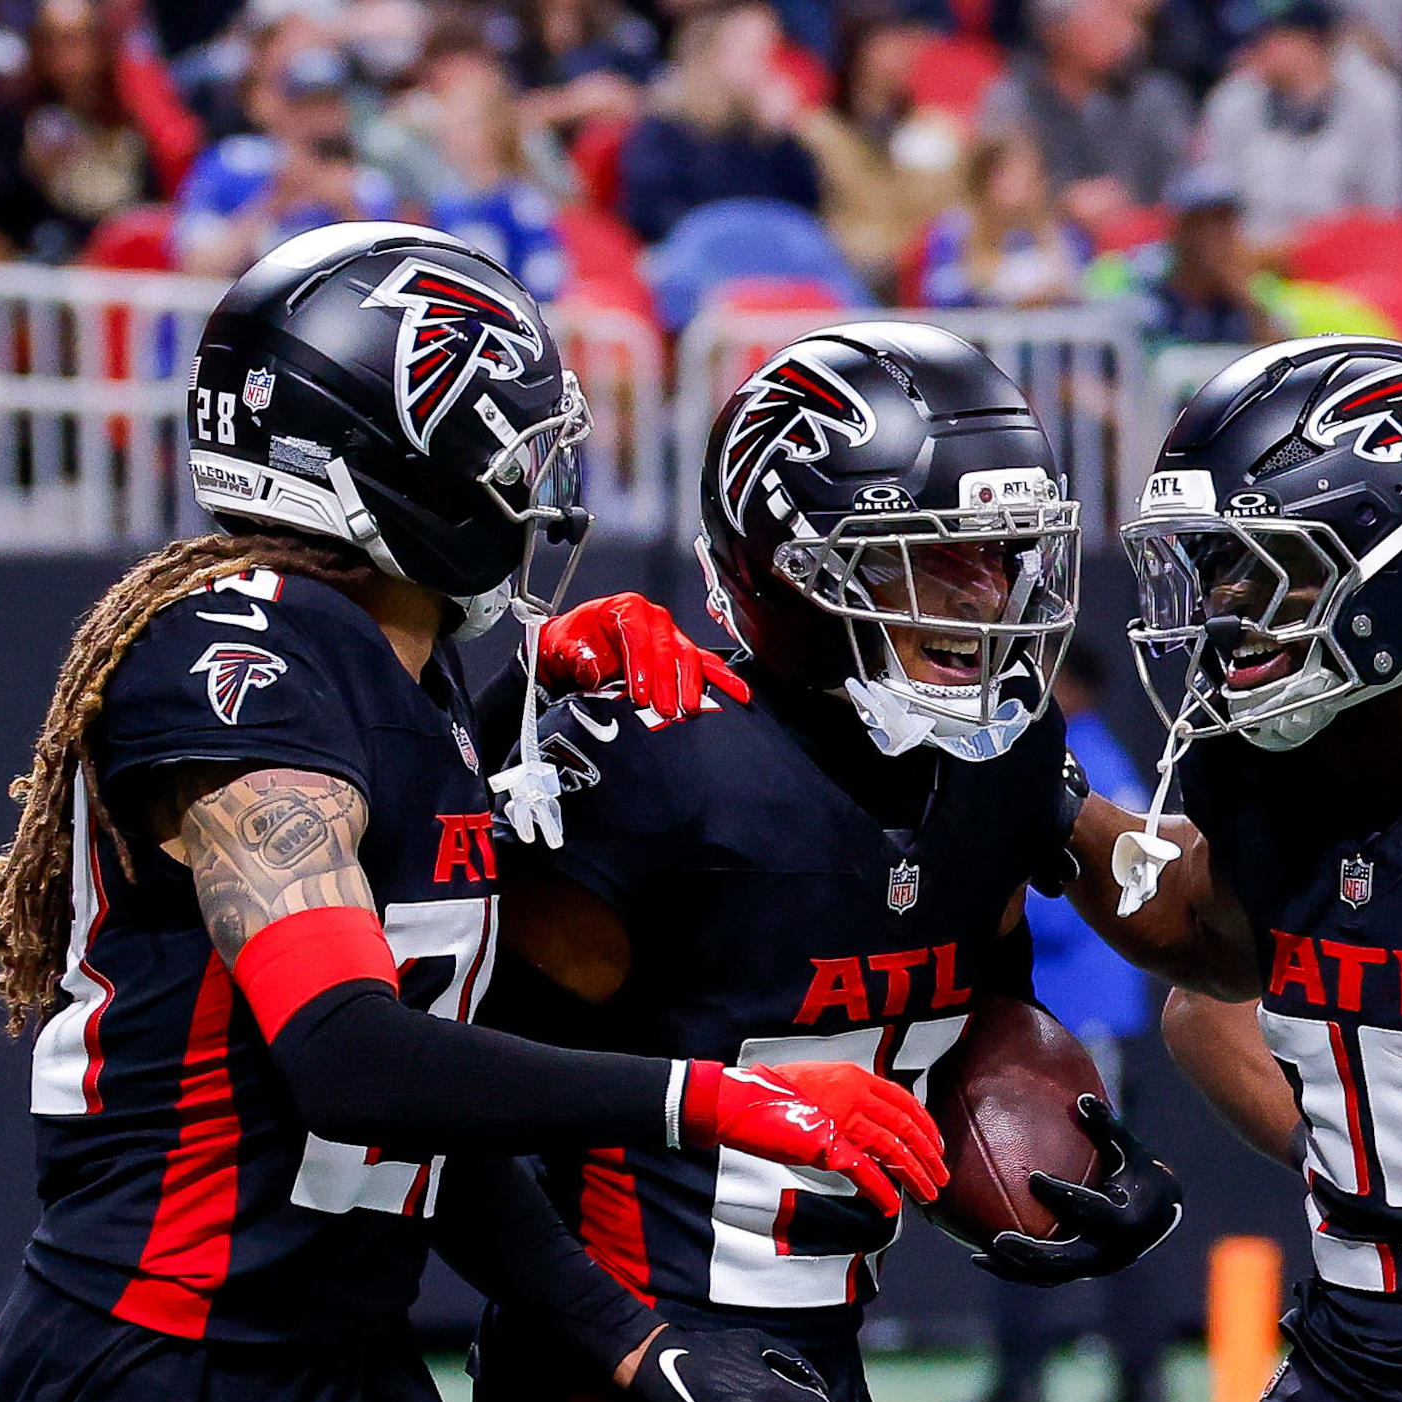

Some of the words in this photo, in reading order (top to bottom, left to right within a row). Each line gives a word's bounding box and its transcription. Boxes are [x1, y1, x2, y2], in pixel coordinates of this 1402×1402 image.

[246, 385, 267, 405] NFL
[197, 387, 237, 446] 28
[1004, 481, 1031, 495] ATL
[1150, 477, 1183, 495] ATL
[854, 501, 911, 511] OAKLEY
[1223, 506, 1278, 518] OAKLEY
[893, 885, 915, 905] NFL
[1345, 879, 1367, 900] NFL
[792, 942, 972, 1025] ATL
